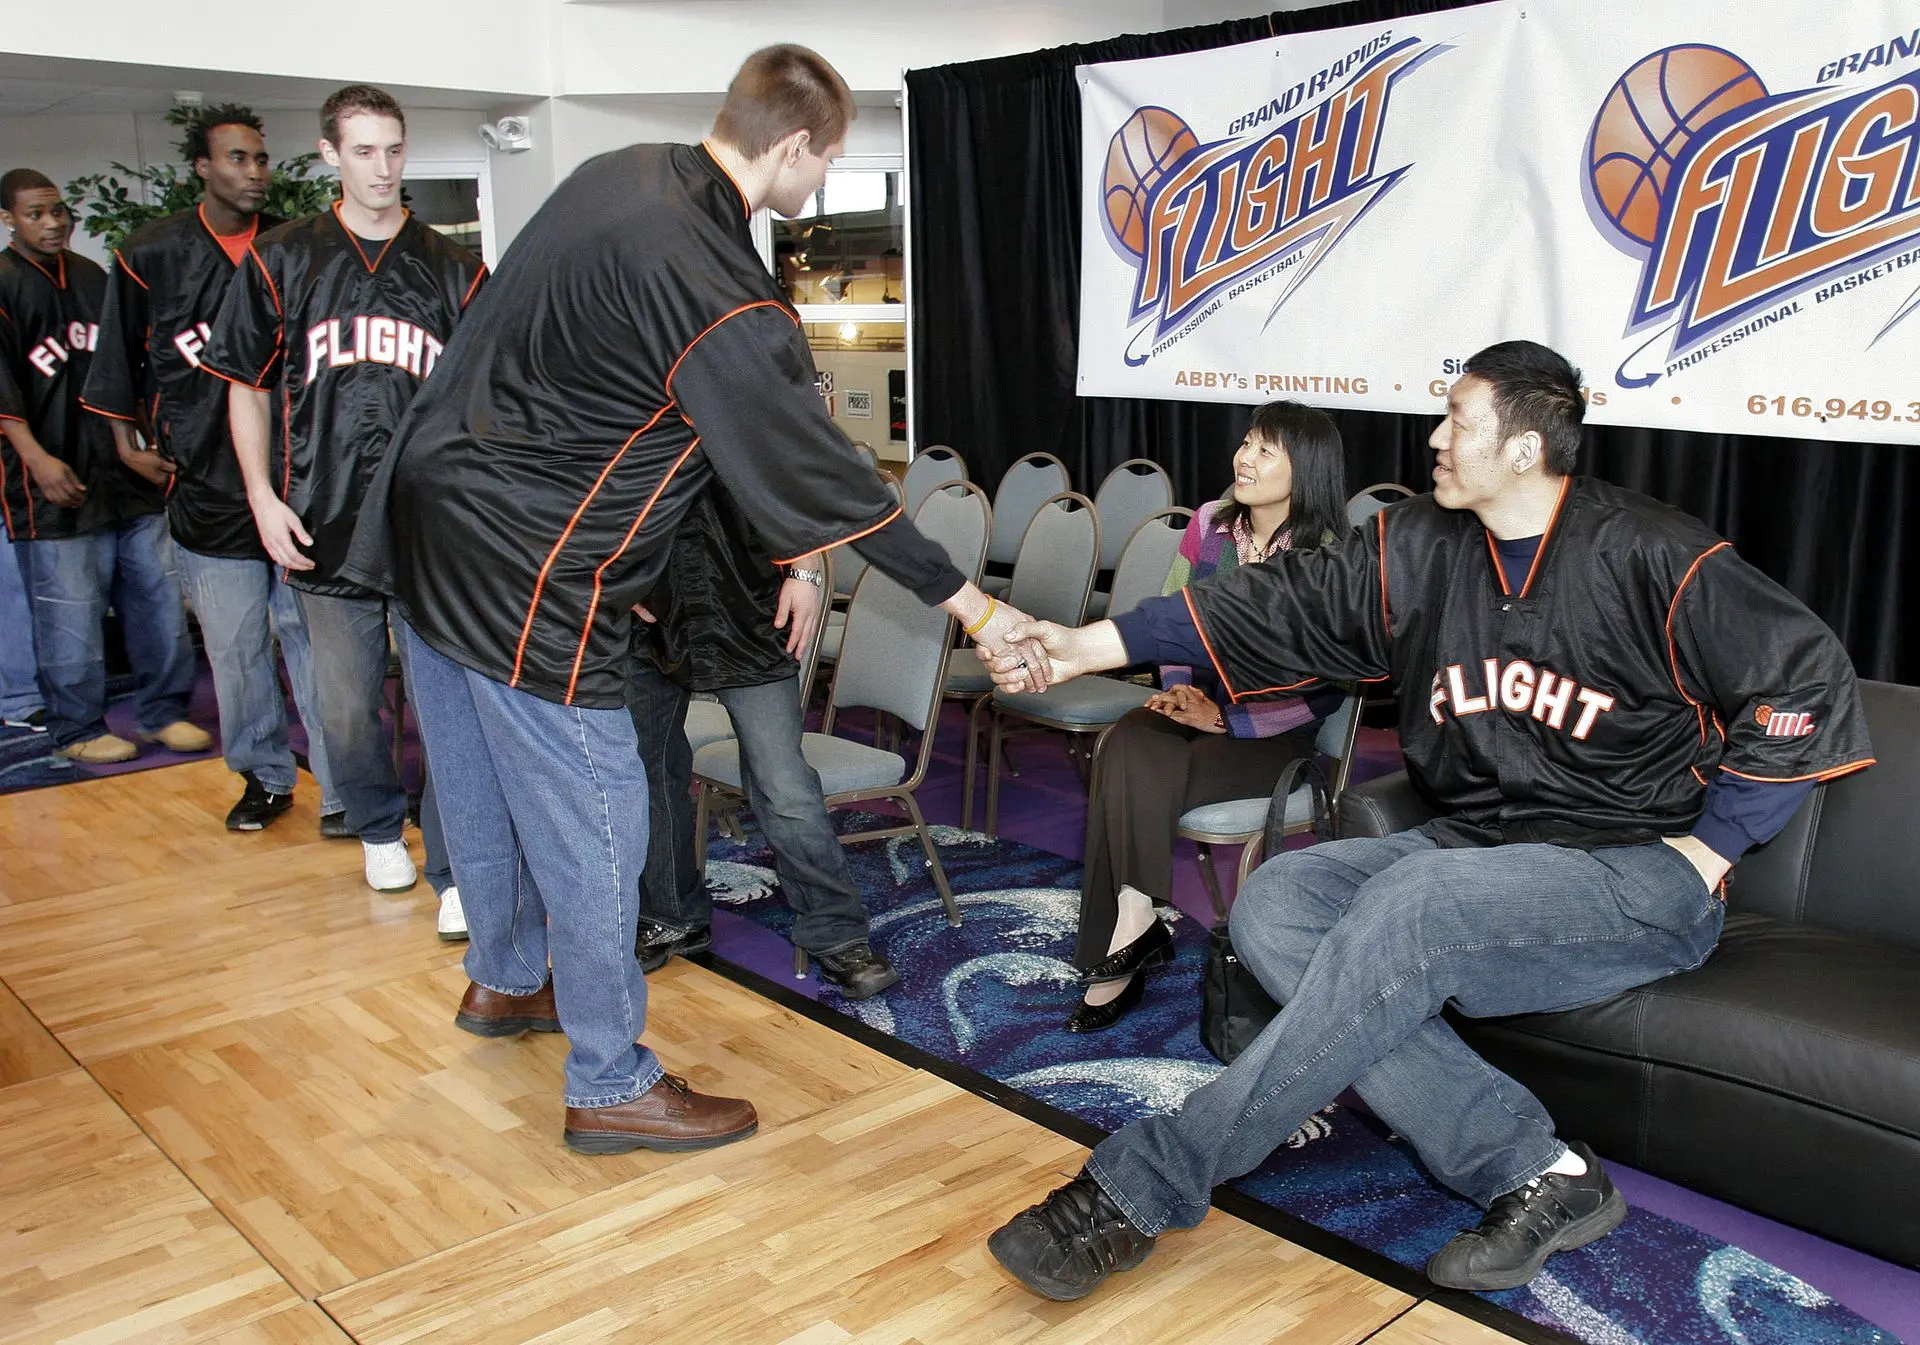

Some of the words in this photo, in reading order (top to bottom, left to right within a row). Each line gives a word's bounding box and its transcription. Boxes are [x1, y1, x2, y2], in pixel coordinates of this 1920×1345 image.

[1228, 82, 1306, 136] GRAND
[1307, 30, 1393, 100] RAPIDS
[1816, 28, 1920, 84] GRAN
[1135, 47, 1410, 325] FLIGHT
[1643, 83, 1920, 330] FLIG
[1151, 298, 1224, 359] PROFESSIONAL
[1228, 250, 1306, 301] BASKETBALL
[1666, 303, 1804, 378] PROFESSIONAL
[305, 315, 444, 384] FLIGHT
[1175, 370, 1248, 389] ABBY's
[1255, 374, 1369, 395] PRINTING
[1429, 657, 1616, 741] FLIGHT
